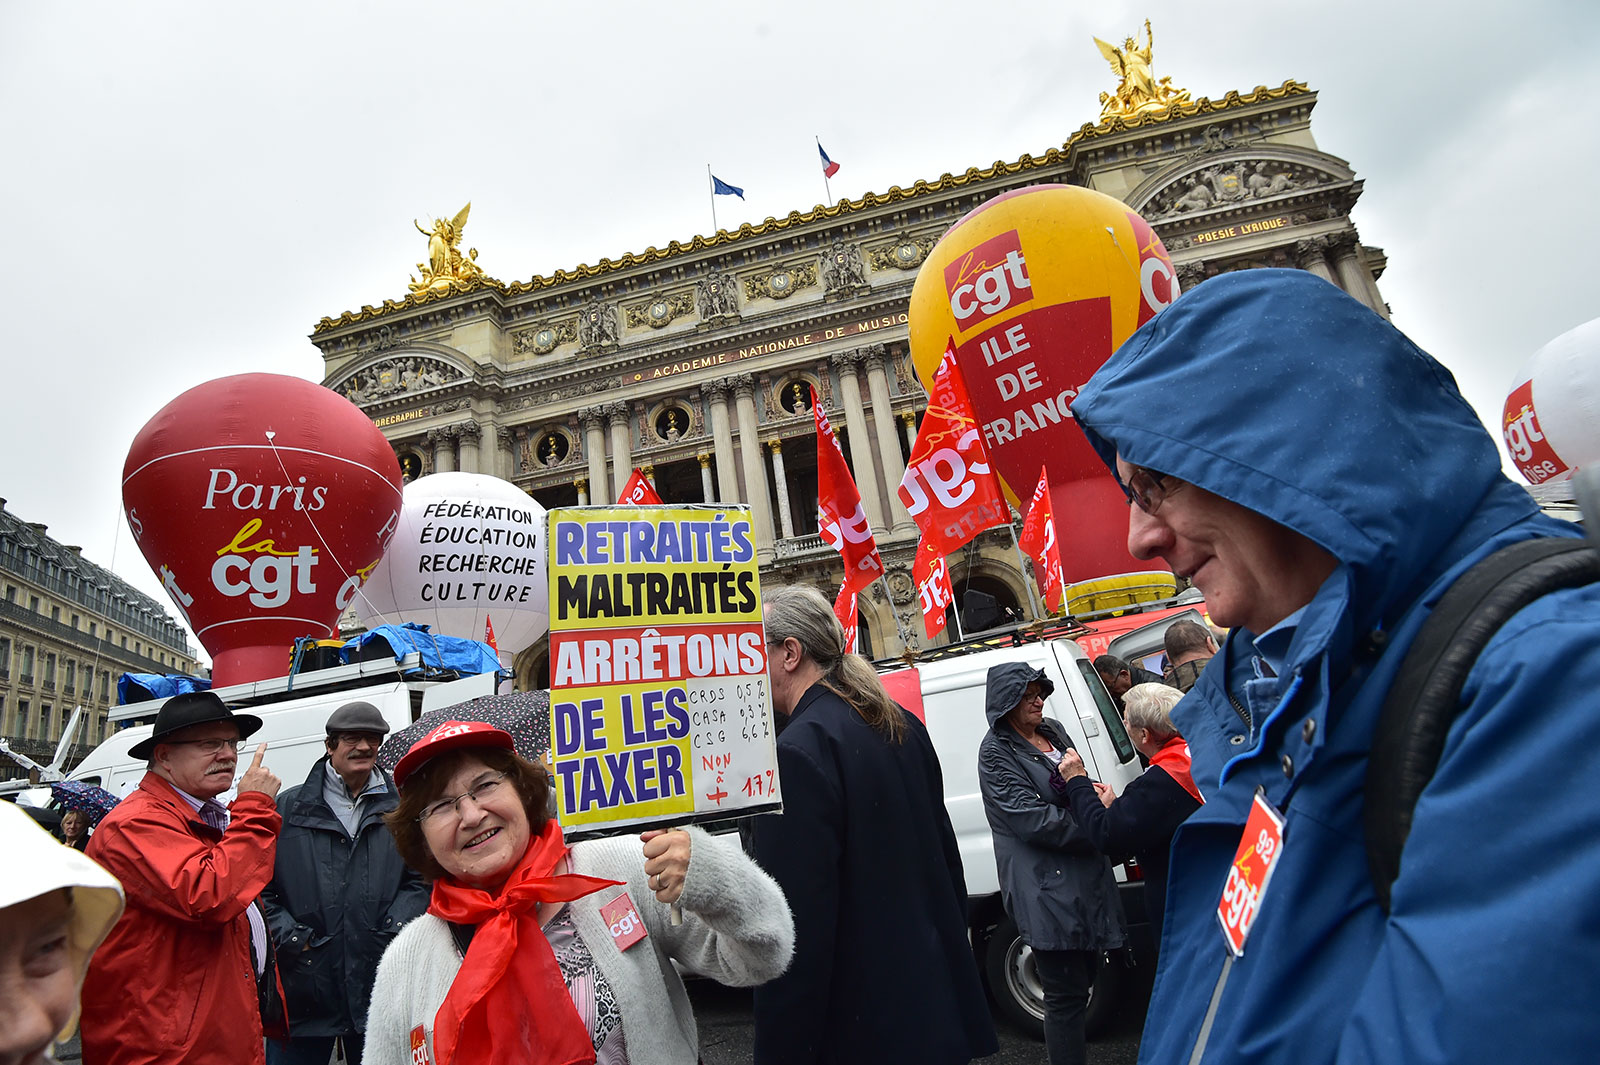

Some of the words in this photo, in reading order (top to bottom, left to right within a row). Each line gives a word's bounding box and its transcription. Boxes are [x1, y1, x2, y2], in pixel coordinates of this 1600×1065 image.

[1197, 227, 1236, 243] POESIE
[1241, 217, 1284, 235] LYRIQUE
[951, 250, 1031, 319] cgt
[653, 353, 726, 379] ACADEMIE
[739, 334, 812, 359] NATIONALE
[825, 327, 845, 340] DE
[858, 312, 909, 333] MUSIQ
[980, 323, 1031, 367] ILE
[995, 361, 1043, 402] DE
[373, 409, 424, 428] OREGRAPHIE
[982, 383, 1087, 449] FRANC
[202, 468, 328, 511] Paris
[423, 500, 532, 525] FÉDÉRATION
[217, 518, 301, 557] la
[420, 522, 536, 549] ÉDUCATION
[555, 514, 755, 567] RETRAITÉS
[211, 546, 319, 609] cgt
[419, 553, 537, 576] RECHERCHE
[421, 582, 532, 602] CULTURE
[557, 563, 757, 620] MALTRAITÉS
[554, 628, 764, 688] ARRÊTONS
[689, 688, 725, 704] CRDS
[554, 698, 608, 756] DE
[620, 686, 691, 748] LES
[692, 709, 726, 727] CASA
[556, 745, 686, 816] TAXER
[702, 752, 731, 772] NON
[1256, 829, 1275, 865] 92
[1223, 866, 1257, 936] cgt
[610, 910, 639, 938] cgt
